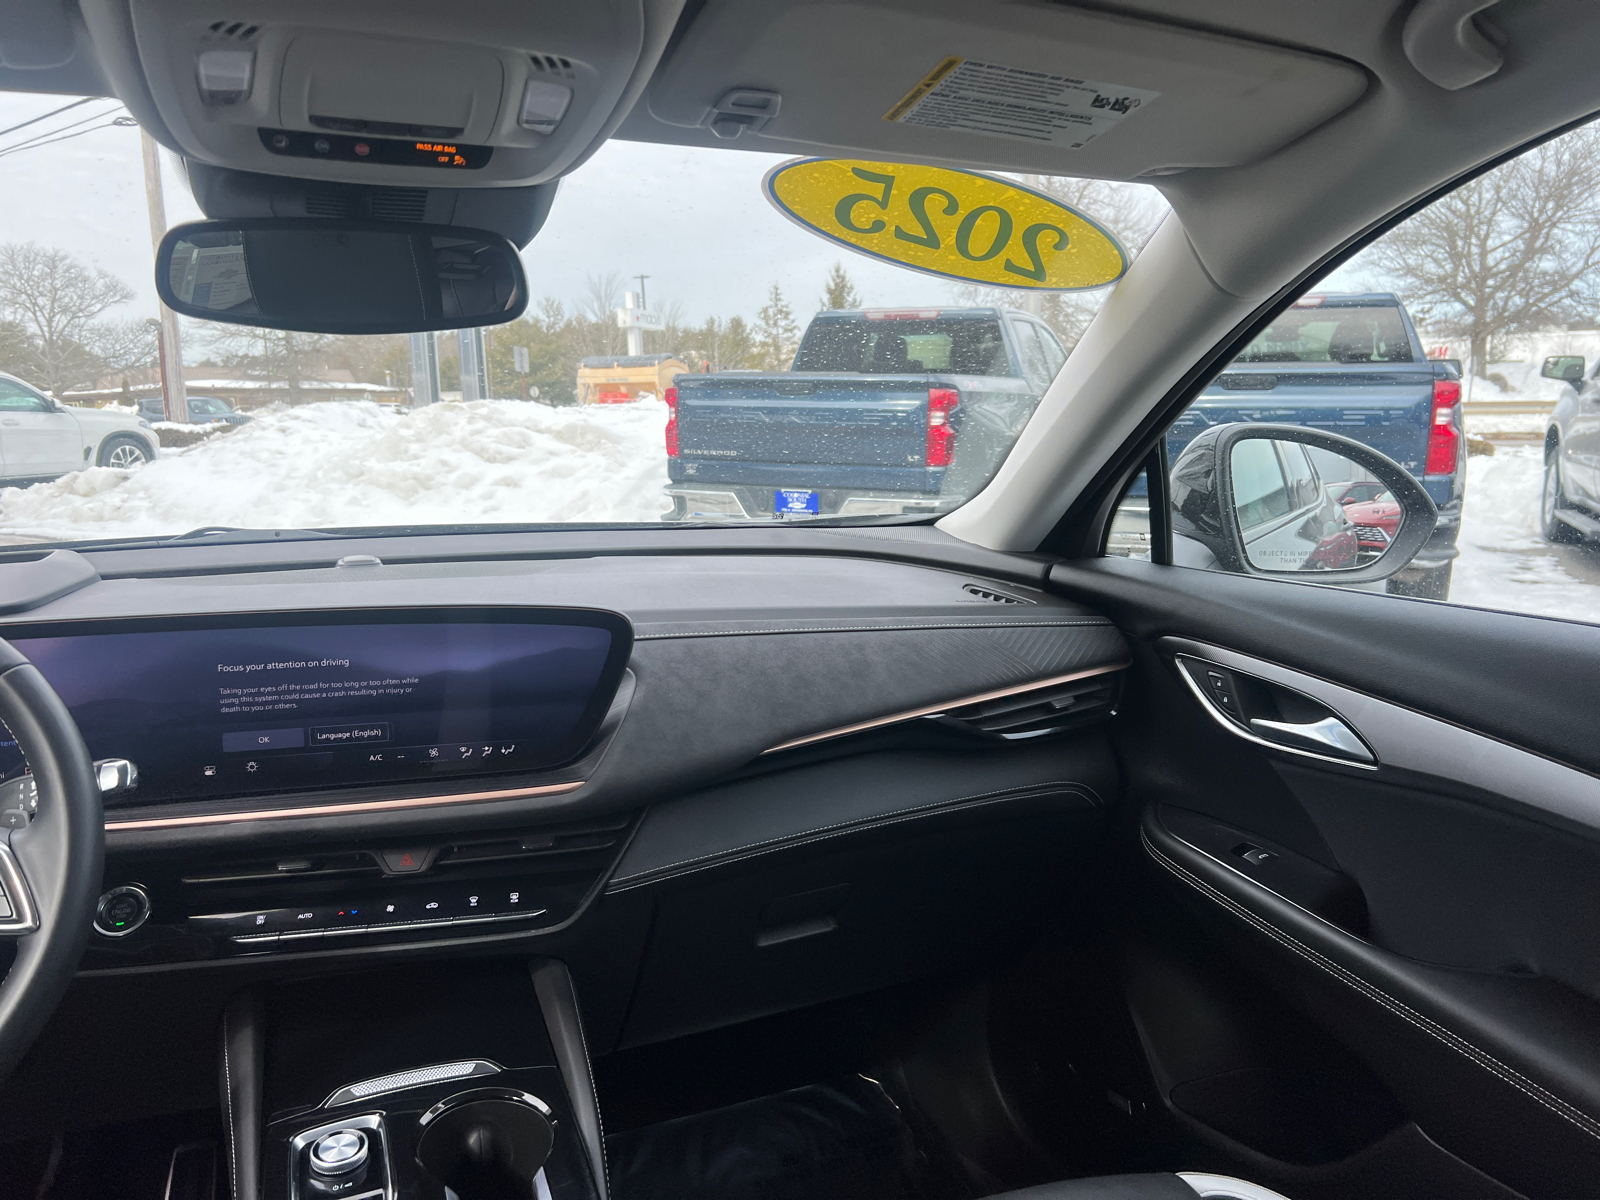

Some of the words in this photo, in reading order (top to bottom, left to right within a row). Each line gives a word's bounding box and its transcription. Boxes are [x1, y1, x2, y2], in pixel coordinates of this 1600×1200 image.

[987, 63, 1008, 74] WITH
[416, 143, 433, 151] PASS
[433, 144, 444, 152] AIR
[444, 145, 457, 153] BAG
[1400, 461, 1418, 469] LT
[1259, 550, 1288, 558] OBJECTS
[217, 664, 244, 672] Focus
[246, 664, 265, 673] your
[266, 661, 306, 670] attention
[307, 660, 319, 668] on
[320, 658, 350, 668] driving
[219, 687, 242, 695] Taking
[243, 687, 259, 695] your
[277, 683, 289, 691] off
[302, 682, 318, 690] road
[343, 681, 359, 689] long
[240, 695, 253, 703] this
[254, 694, 280, 703] system
[280, 692, 300, 700] could
[327, 690, 347, 698] crash
[347, 688, 377, 697] resulting
[385, 686, 405, 695] injury
[220, 705, 241, 713] death
[251, 705, 264, 713] you
[317, 730, 351, 741] Language
[351, 728, 382, 739] (English)
[258, 736, 271, 744] OK
[369, 754, 383, 762] A/C
[19, 803, 24, 811] D
[297, 912, 313, 920] AUTO
